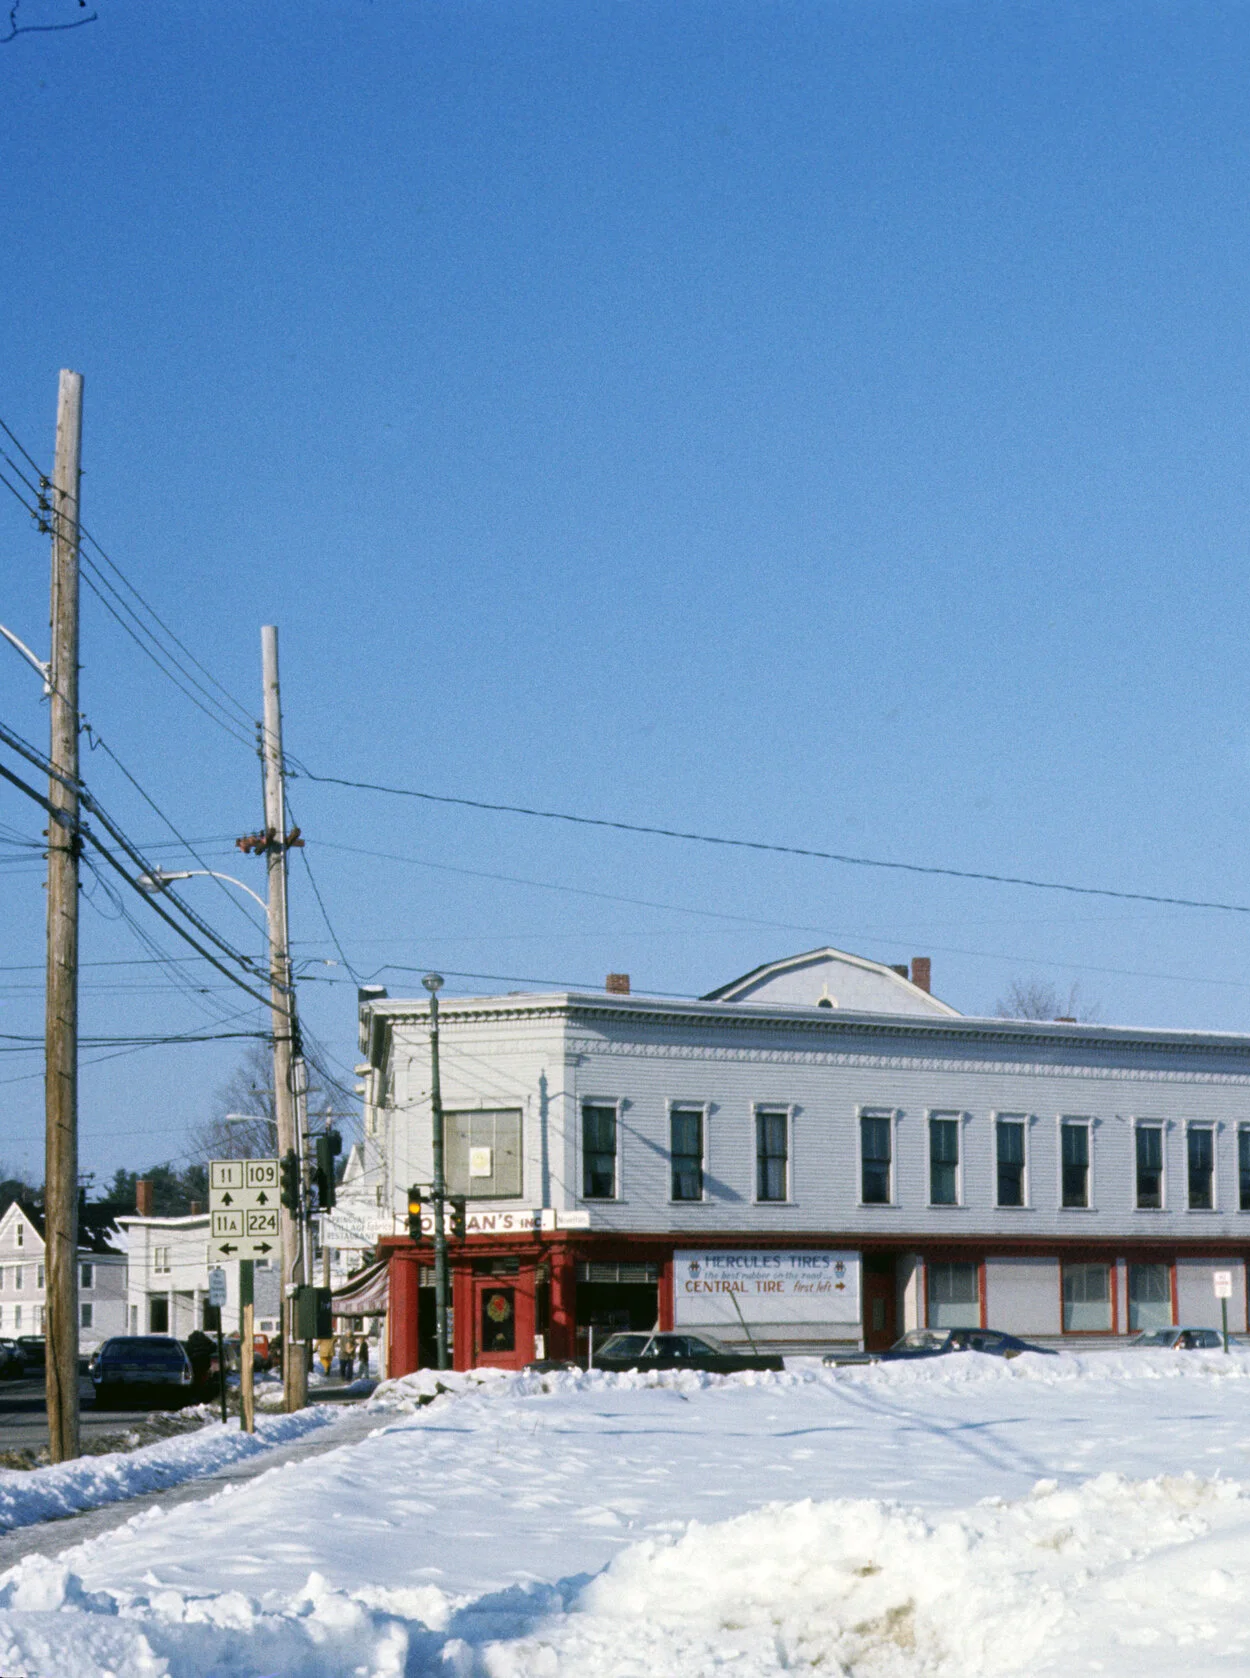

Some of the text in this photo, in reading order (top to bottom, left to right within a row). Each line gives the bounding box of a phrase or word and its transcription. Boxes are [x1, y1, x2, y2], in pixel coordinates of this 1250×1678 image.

[221, 1168, 232, 1183] 11
[250, 1167, 274, 1182] 109
[217, 1216, 237, 1231] 11A
[249, 1215, 276, 1230] 224
[520, 1217, 546, 1229] INC.
[705, 1255, 830, 1268] HERCULES TIRES
[685, 1280, 833, 1293] CENTRAL TIRE first left
